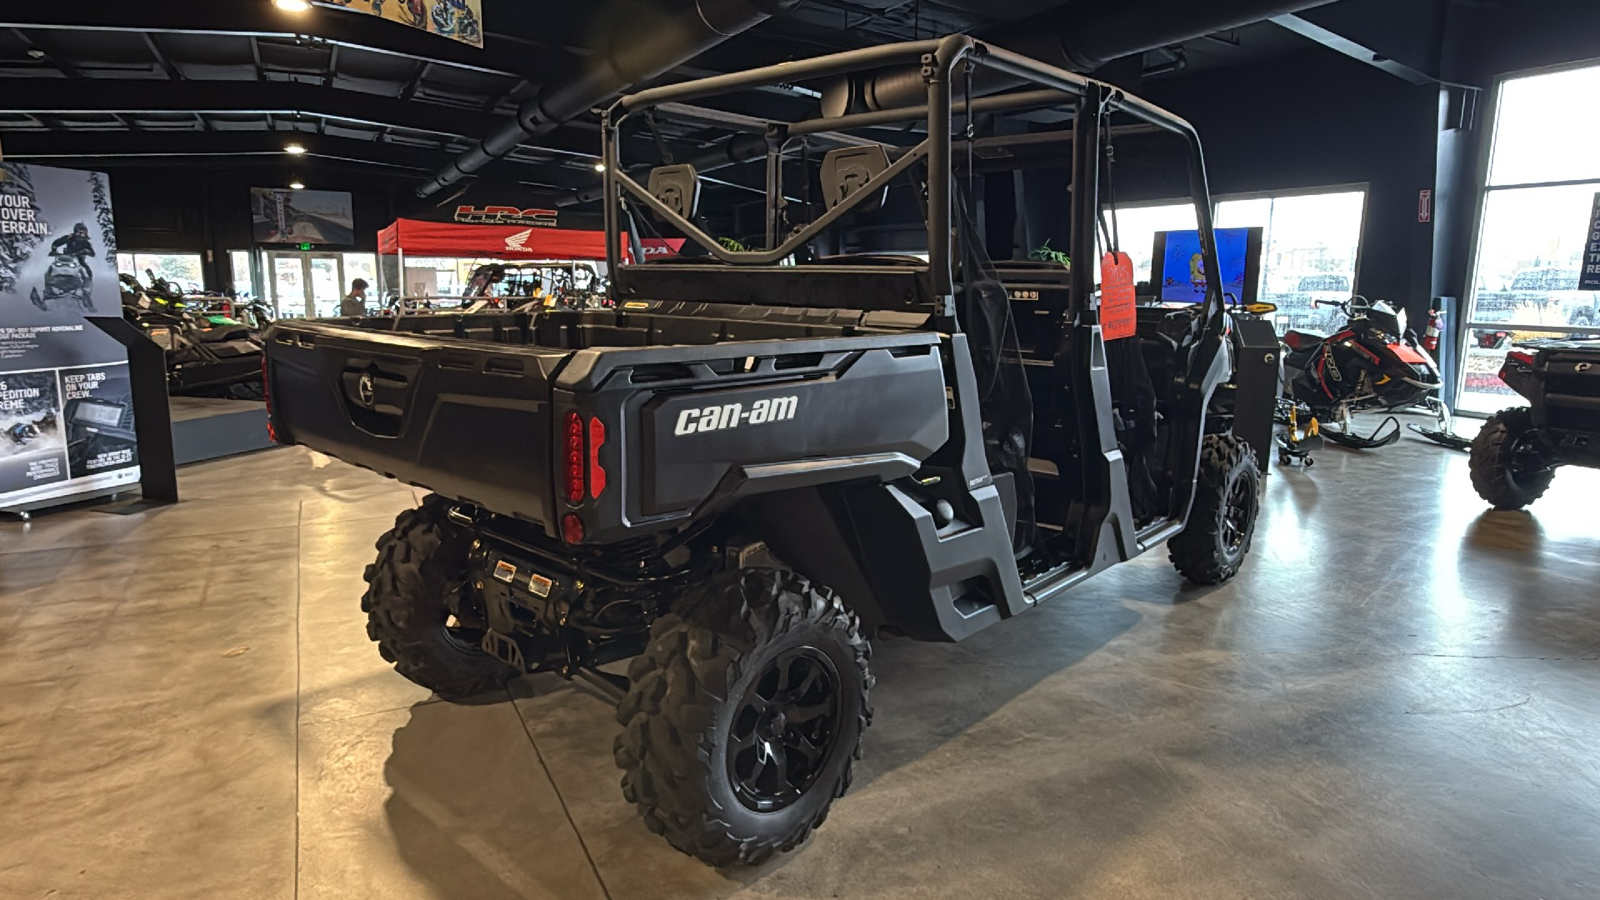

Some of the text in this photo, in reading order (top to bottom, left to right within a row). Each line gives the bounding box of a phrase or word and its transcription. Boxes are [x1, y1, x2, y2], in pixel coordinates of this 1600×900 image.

[1, 207, 36, 221] OVER
[454, 205, 559, 226] HRC
[0, 220, 52, 235] ERRAIN.
[65, 372, 106, 383] KEEP TABS
[66, 381, 99, 392] ON YOUR
[66, 390, 93, 400] CREW.
[674, 395, 798, 436] can-am
